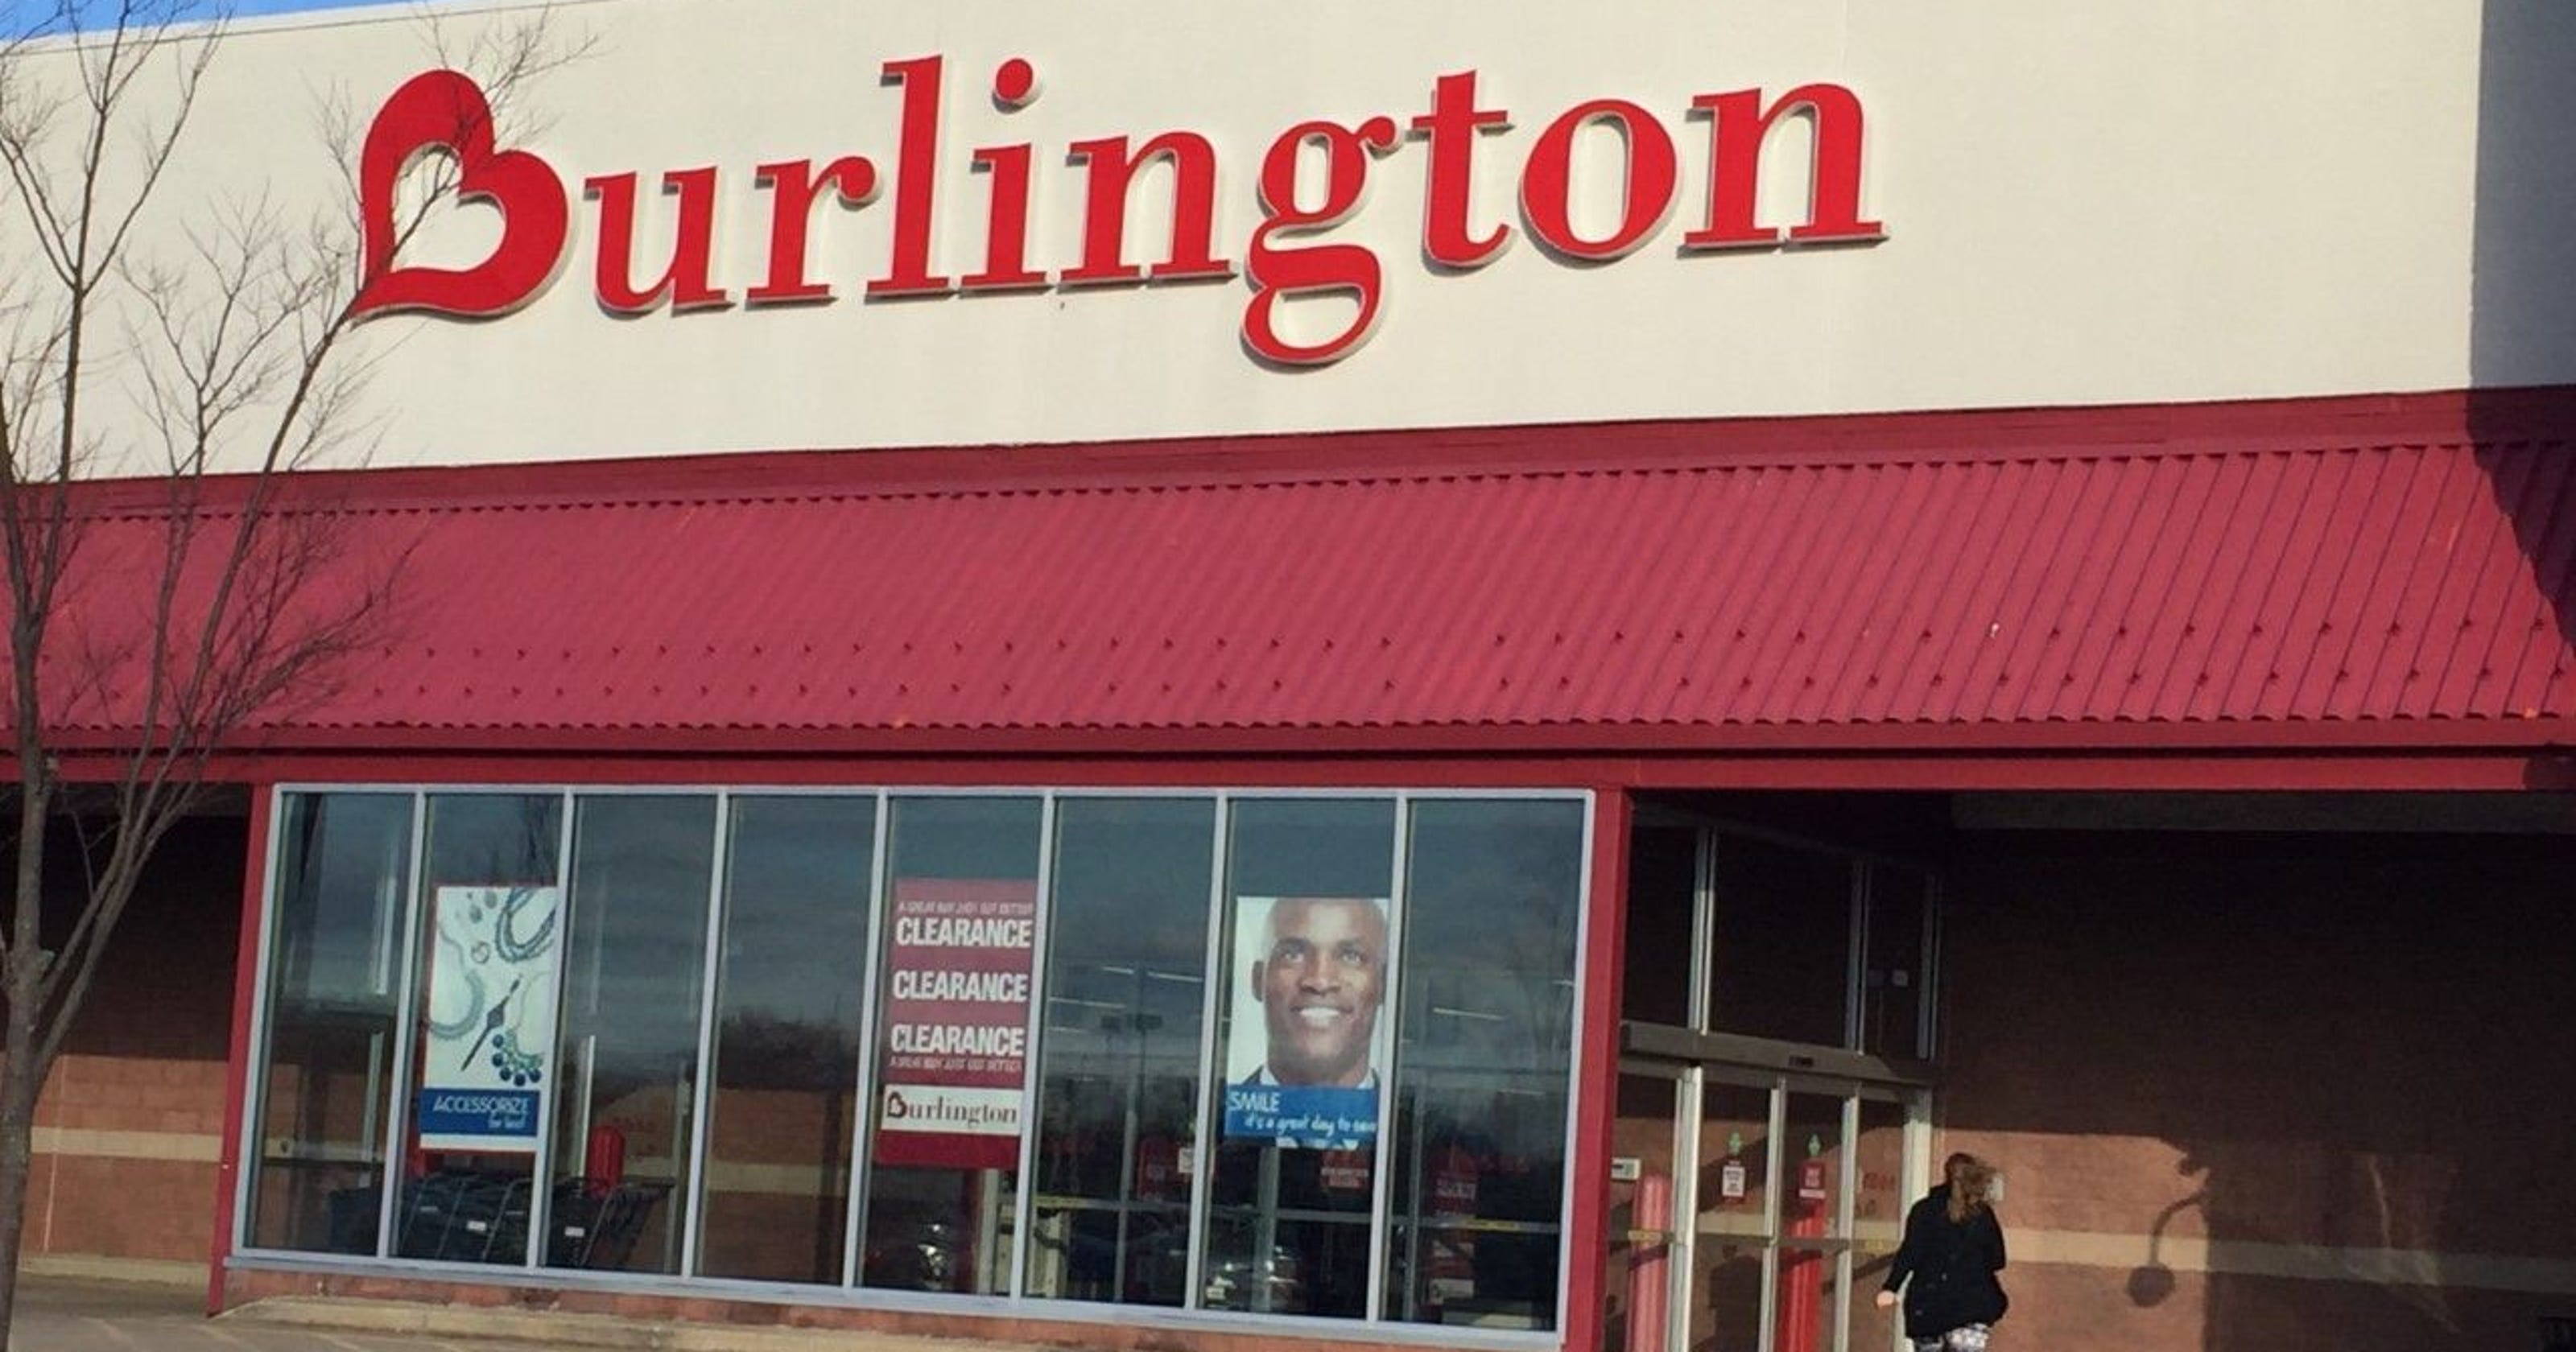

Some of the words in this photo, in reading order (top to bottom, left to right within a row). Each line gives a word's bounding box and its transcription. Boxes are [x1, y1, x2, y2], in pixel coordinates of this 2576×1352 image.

[352, 55, 1889, 367] Burlington
[896, 916, 1033, 948] CLEARANCE
[893, 970, 1029, 1003] CLEARANCE
[890, 1024, 1025, 1057] CLEARANCE
[432, 1095, 530, 1115] ACCESSORIZE
[886, 1091, 1018, 1129] Burlington
[1228, 1091, 1282, 1112] SMILE
[1276, 1114, 1309, 1136] great
[1311, 1113, 1335, 1136] day
